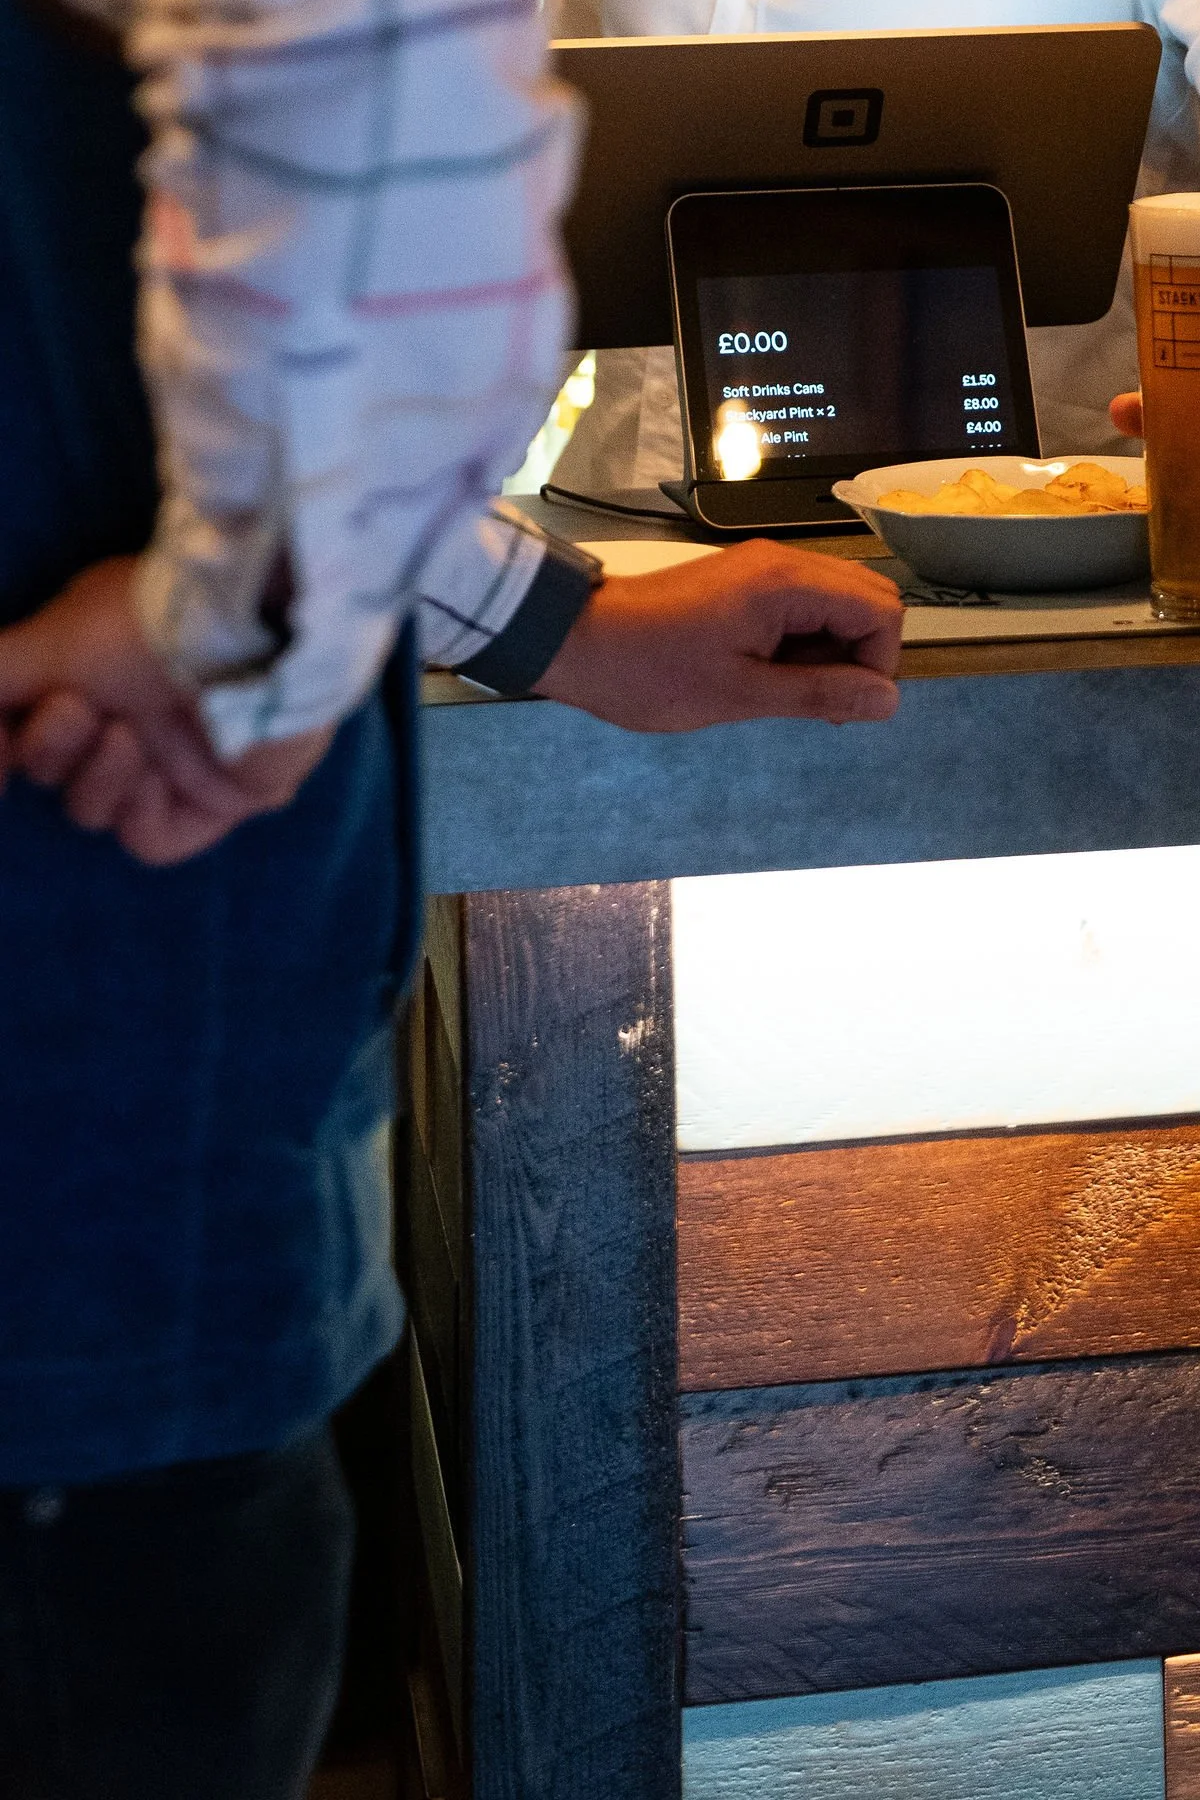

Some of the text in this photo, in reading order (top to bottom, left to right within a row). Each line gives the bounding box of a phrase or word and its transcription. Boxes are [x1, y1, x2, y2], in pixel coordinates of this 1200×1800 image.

[718, 330, 788, 355] £0.00
[962, 374, 996, 387] £1.50
[722, 383, 825, 398] Soft Drinks Cans
[963, 397, 999, 410] £8.00
[789, 406, 815, 419] Pint
[827, 405, 836, 417] 2
[966, 420, 1002, 434] £4.00
[761, 431, 809, 444] Ale Pint
